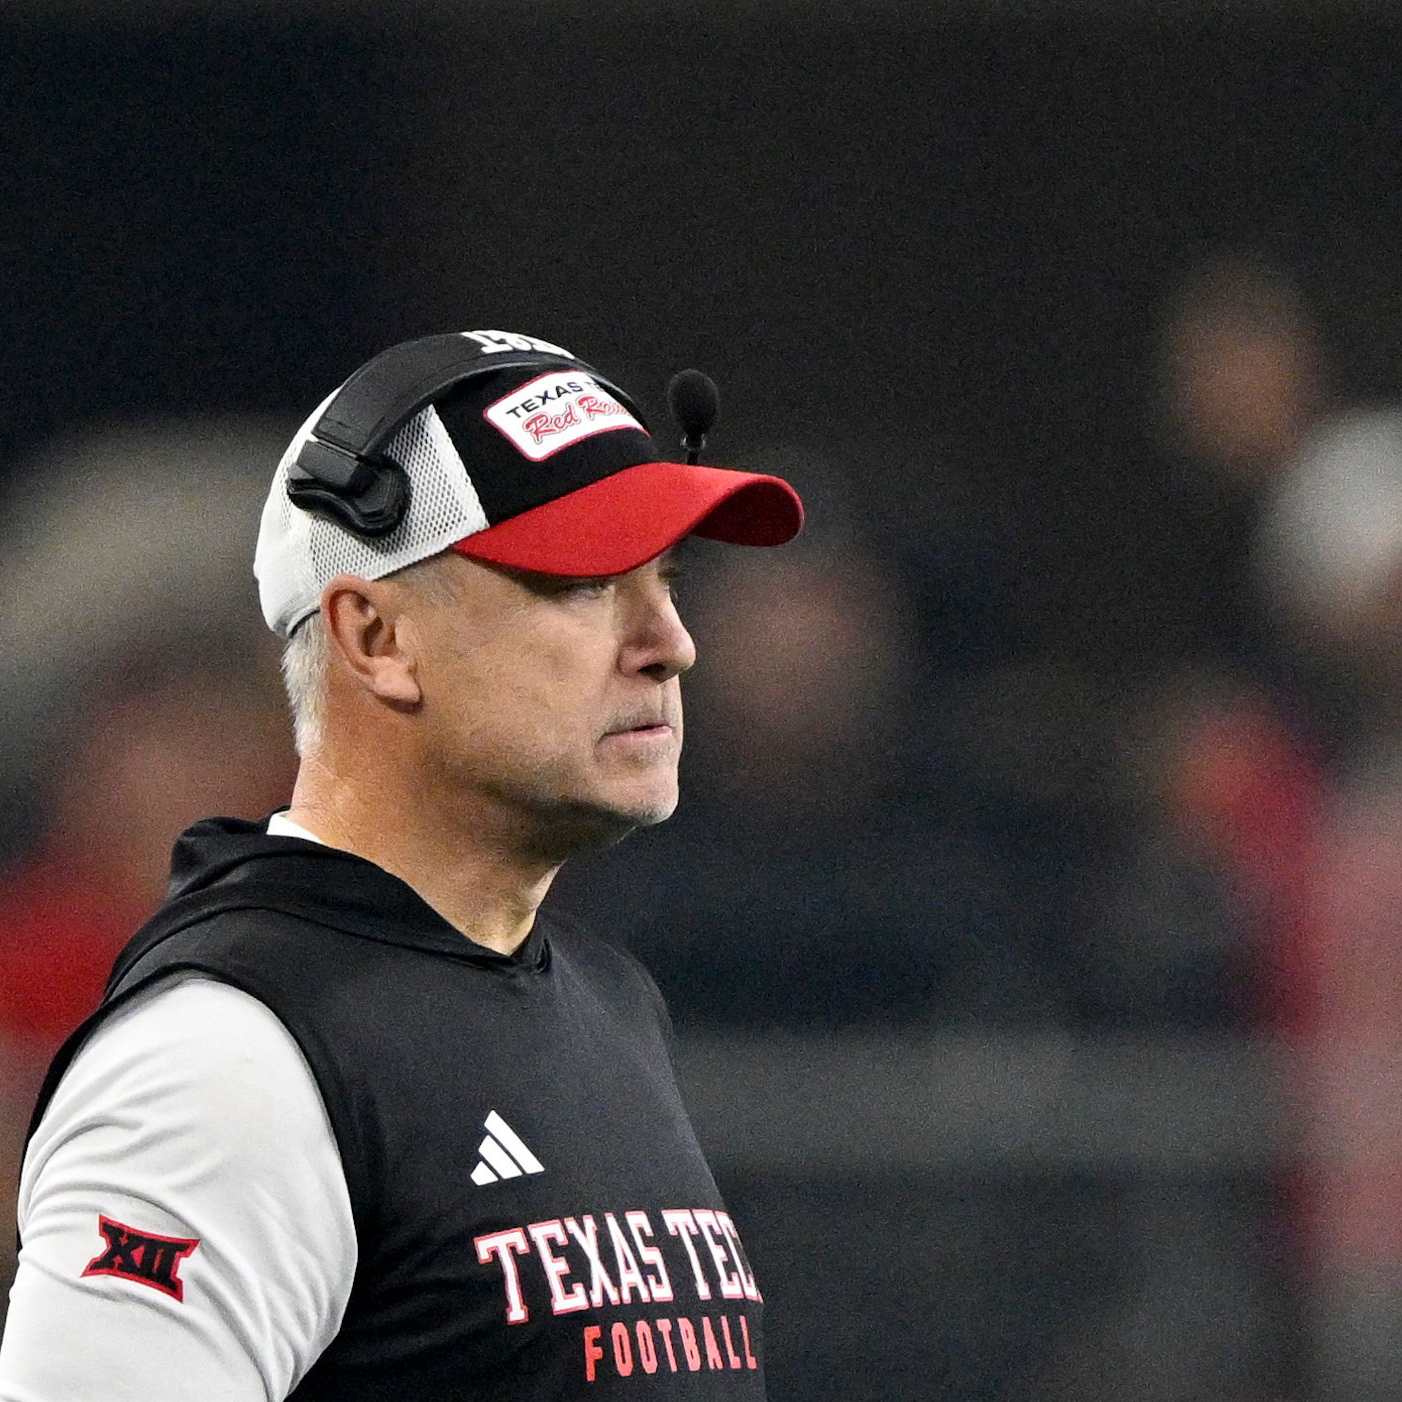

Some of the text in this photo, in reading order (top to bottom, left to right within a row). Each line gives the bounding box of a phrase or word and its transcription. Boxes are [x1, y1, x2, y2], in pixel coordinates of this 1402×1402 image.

[505, 381, 583, 419] TEXAS
[522, 402, 582, 445] Red
[473, 1208, 763, 1326] TEXAS TEC
[583, 1315, 758, 1382] FOOTBALL
